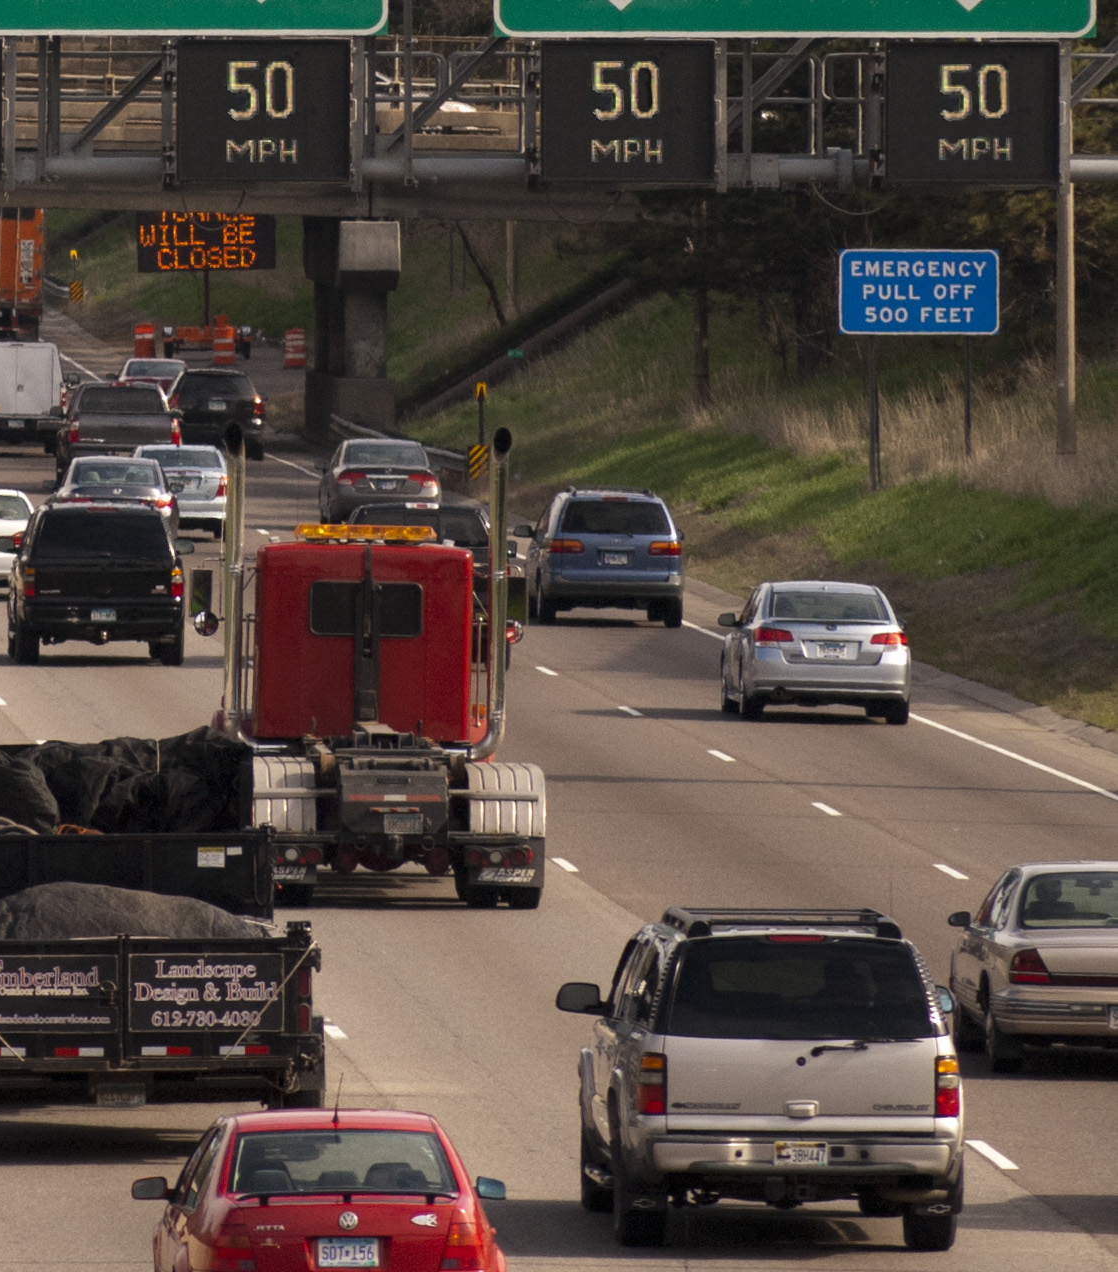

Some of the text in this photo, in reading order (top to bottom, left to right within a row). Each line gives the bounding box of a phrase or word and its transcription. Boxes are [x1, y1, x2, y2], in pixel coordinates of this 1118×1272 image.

[227, 60, 295, 120] 50
[592, 60, 660, 120] 50
[939, 63, 1007, 123] 50
[226, 138, 298, 164] MPH
[591, 138, 662, 164] MPH
[938, 137, 1012, 162] MPH
[139, 221, 255, 247] WILL BE
[157, 246, 256, 270] CLOSED
[850, 260, 987, 278] EMERGENCY
[862, 283, 977, 301] PULL OFF
[864, 306, 975, 324] 500 FEET
[155, 959, 257, 982] Landscape
[134, 981, 278, 1005] Design & Build
